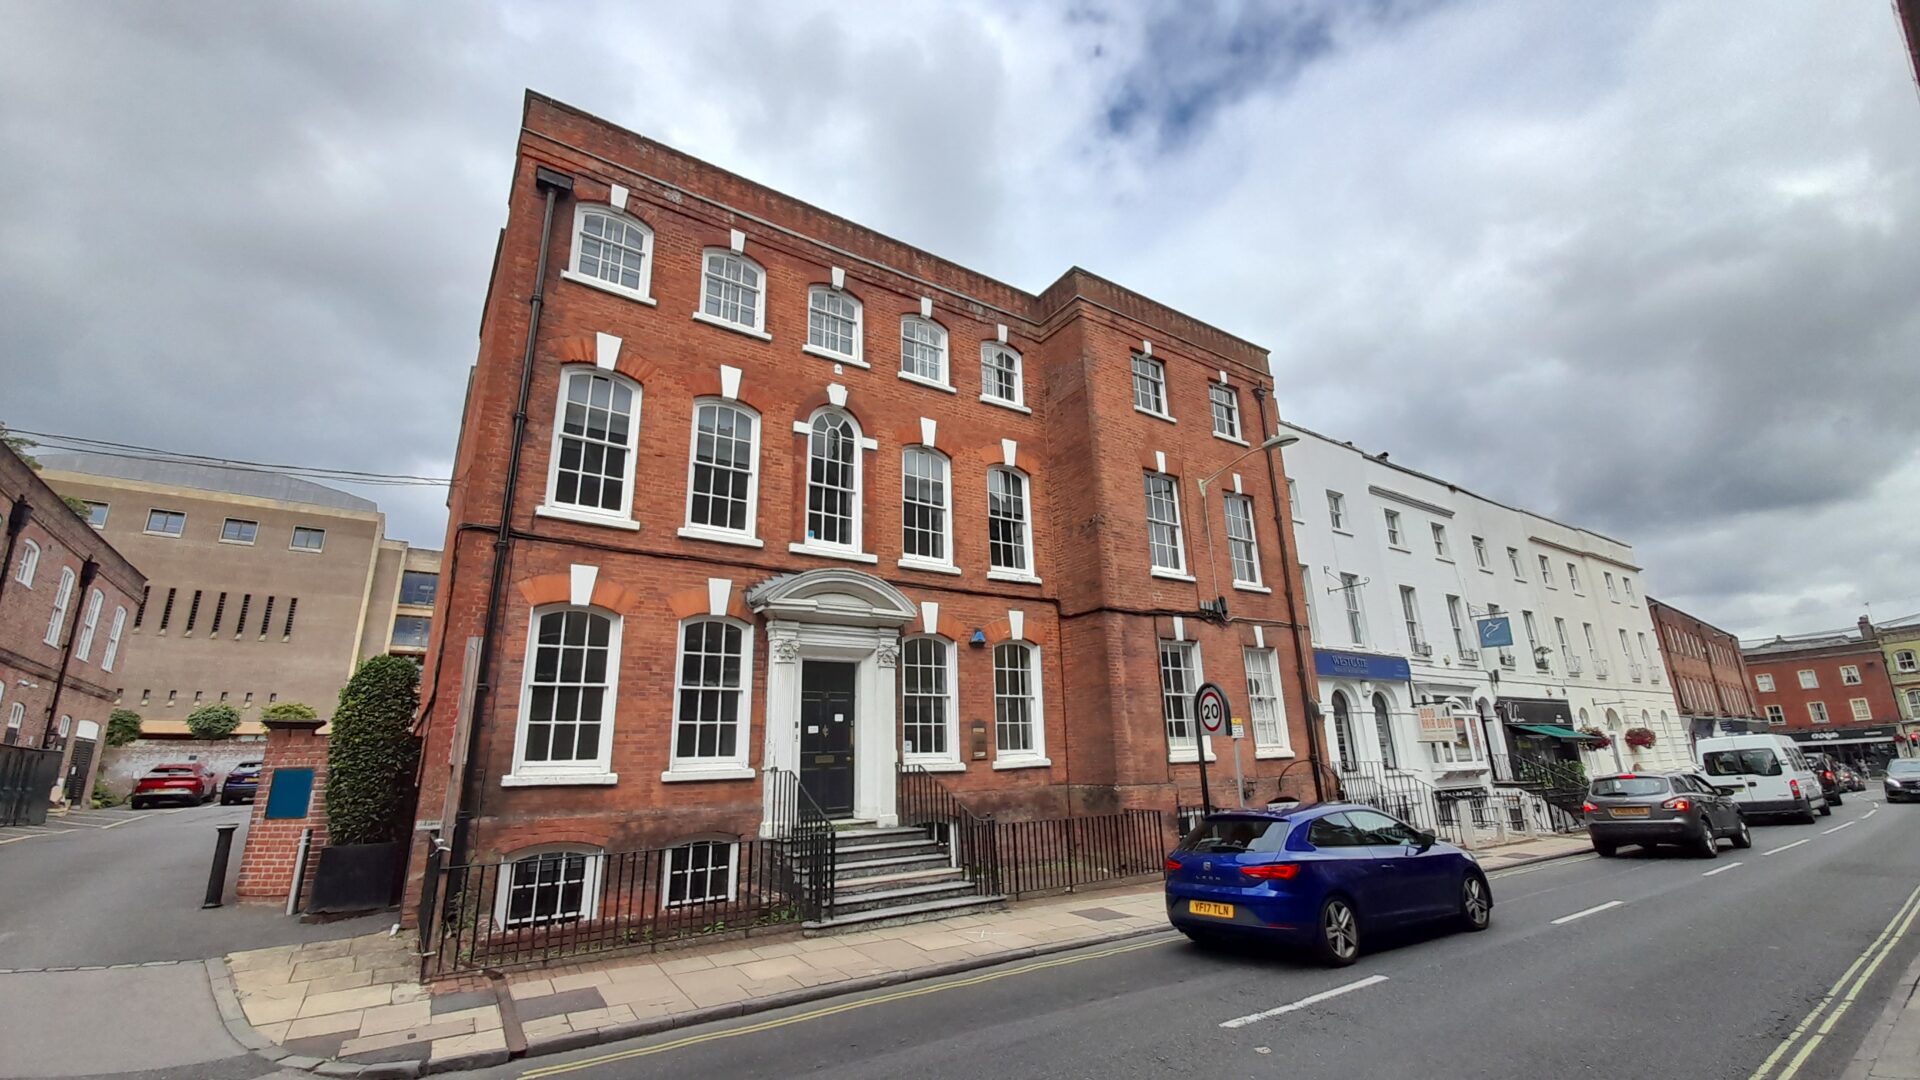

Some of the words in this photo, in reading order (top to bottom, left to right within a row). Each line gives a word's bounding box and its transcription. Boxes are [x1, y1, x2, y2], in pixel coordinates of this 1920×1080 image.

[1332, 655, 1369, 669] WESTGATE
[1203, 703, 1219, 720] 20
[1194, 902, 1212, 913] YF17
[1213, 904, 1229, 916] TLN
